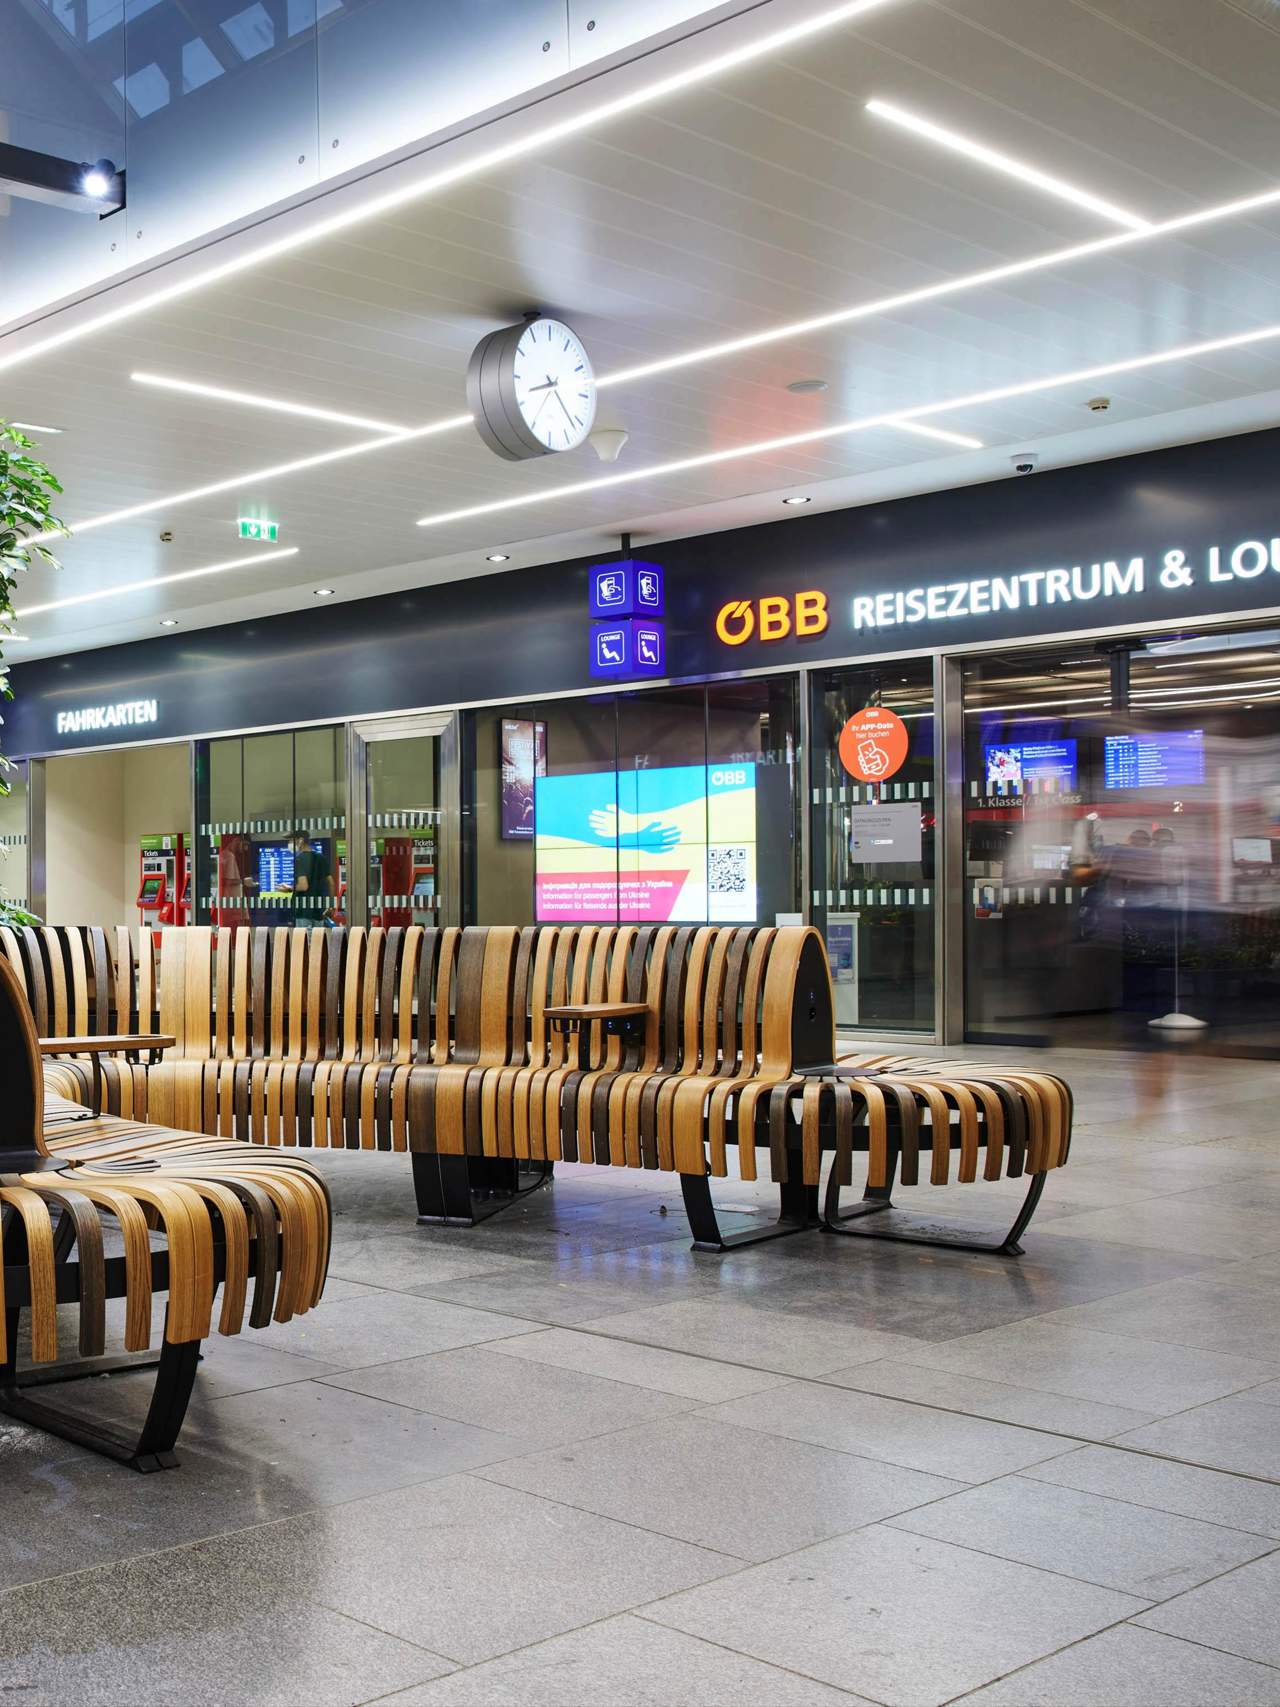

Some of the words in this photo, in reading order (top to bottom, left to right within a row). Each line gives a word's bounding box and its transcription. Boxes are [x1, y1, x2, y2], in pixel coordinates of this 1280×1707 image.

[853, 557, 1144, 629] REISEZENTRUM
[1160, 549, 1194, 588] &
[715, 590, 829, 646] ÖBB
[57, 699, 158, 734] FAHRKARTEN
[711, 769, 747, 786] ÖBB
[988, 797, 1023, 807] Klasse
[414, 839, 434, 847] Tickets
